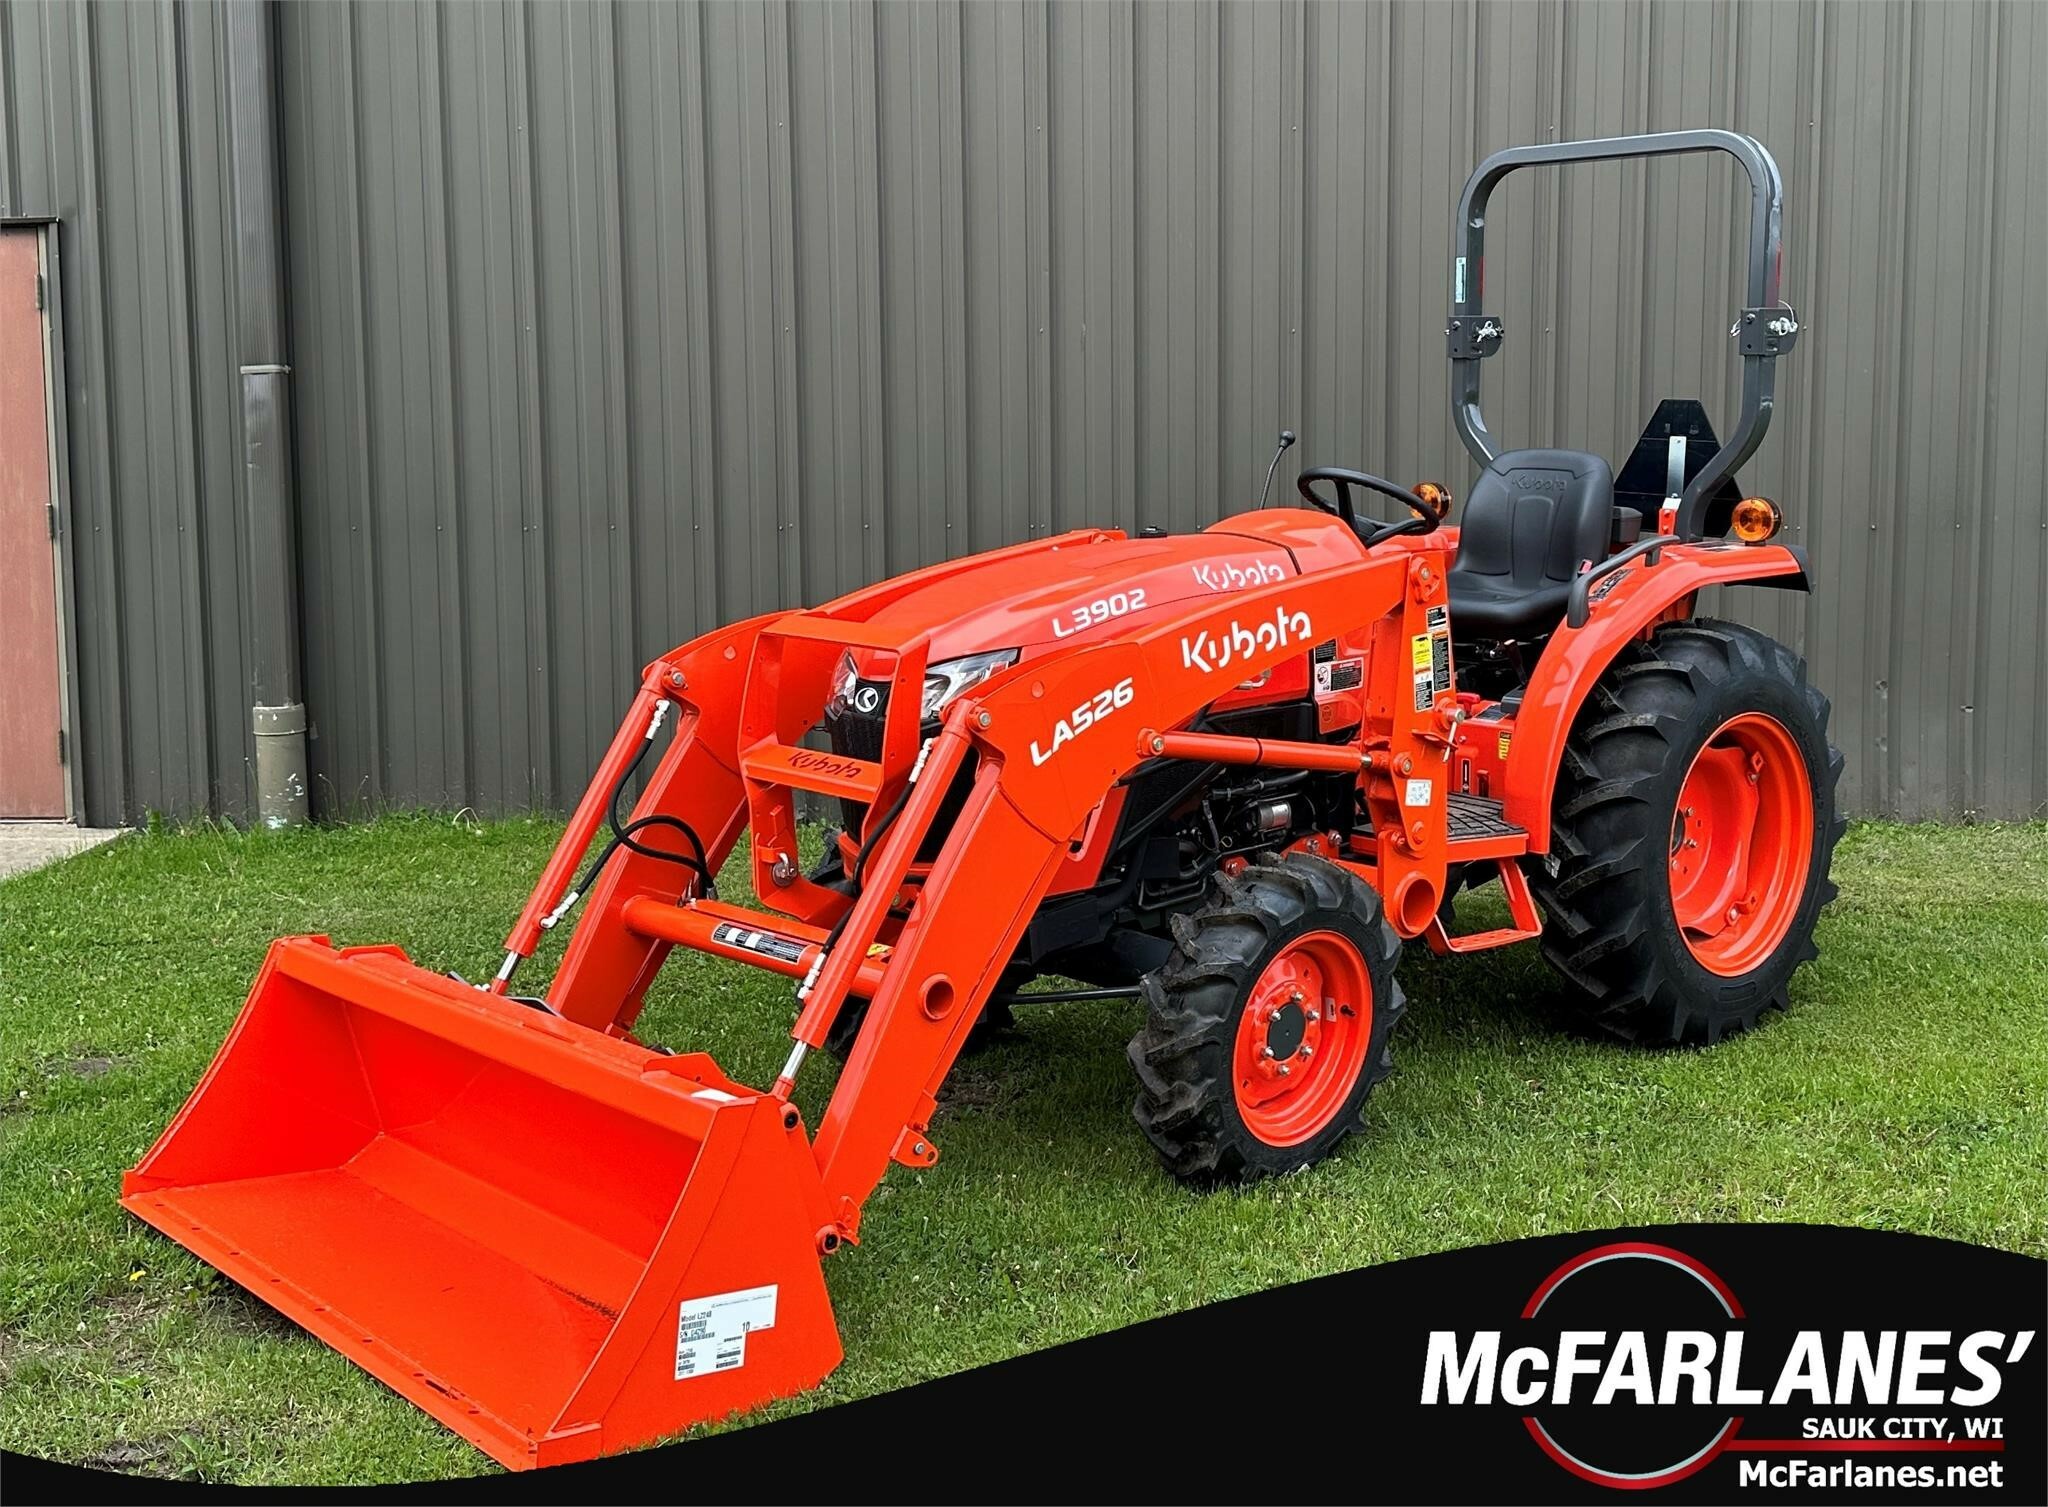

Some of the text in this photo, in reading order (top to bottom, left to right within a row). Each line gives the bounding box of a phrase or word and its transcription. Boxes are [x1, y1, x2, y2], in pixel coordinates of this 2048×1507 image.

[1192, 560, 1285, 591] Kubota
[1052, 588, 1148, 638] L3902
[1181, 606, 1312, 673] Kubota
[1030, 677, 1134, 767] LA526
[788, 751, 862, 779] Kubota
